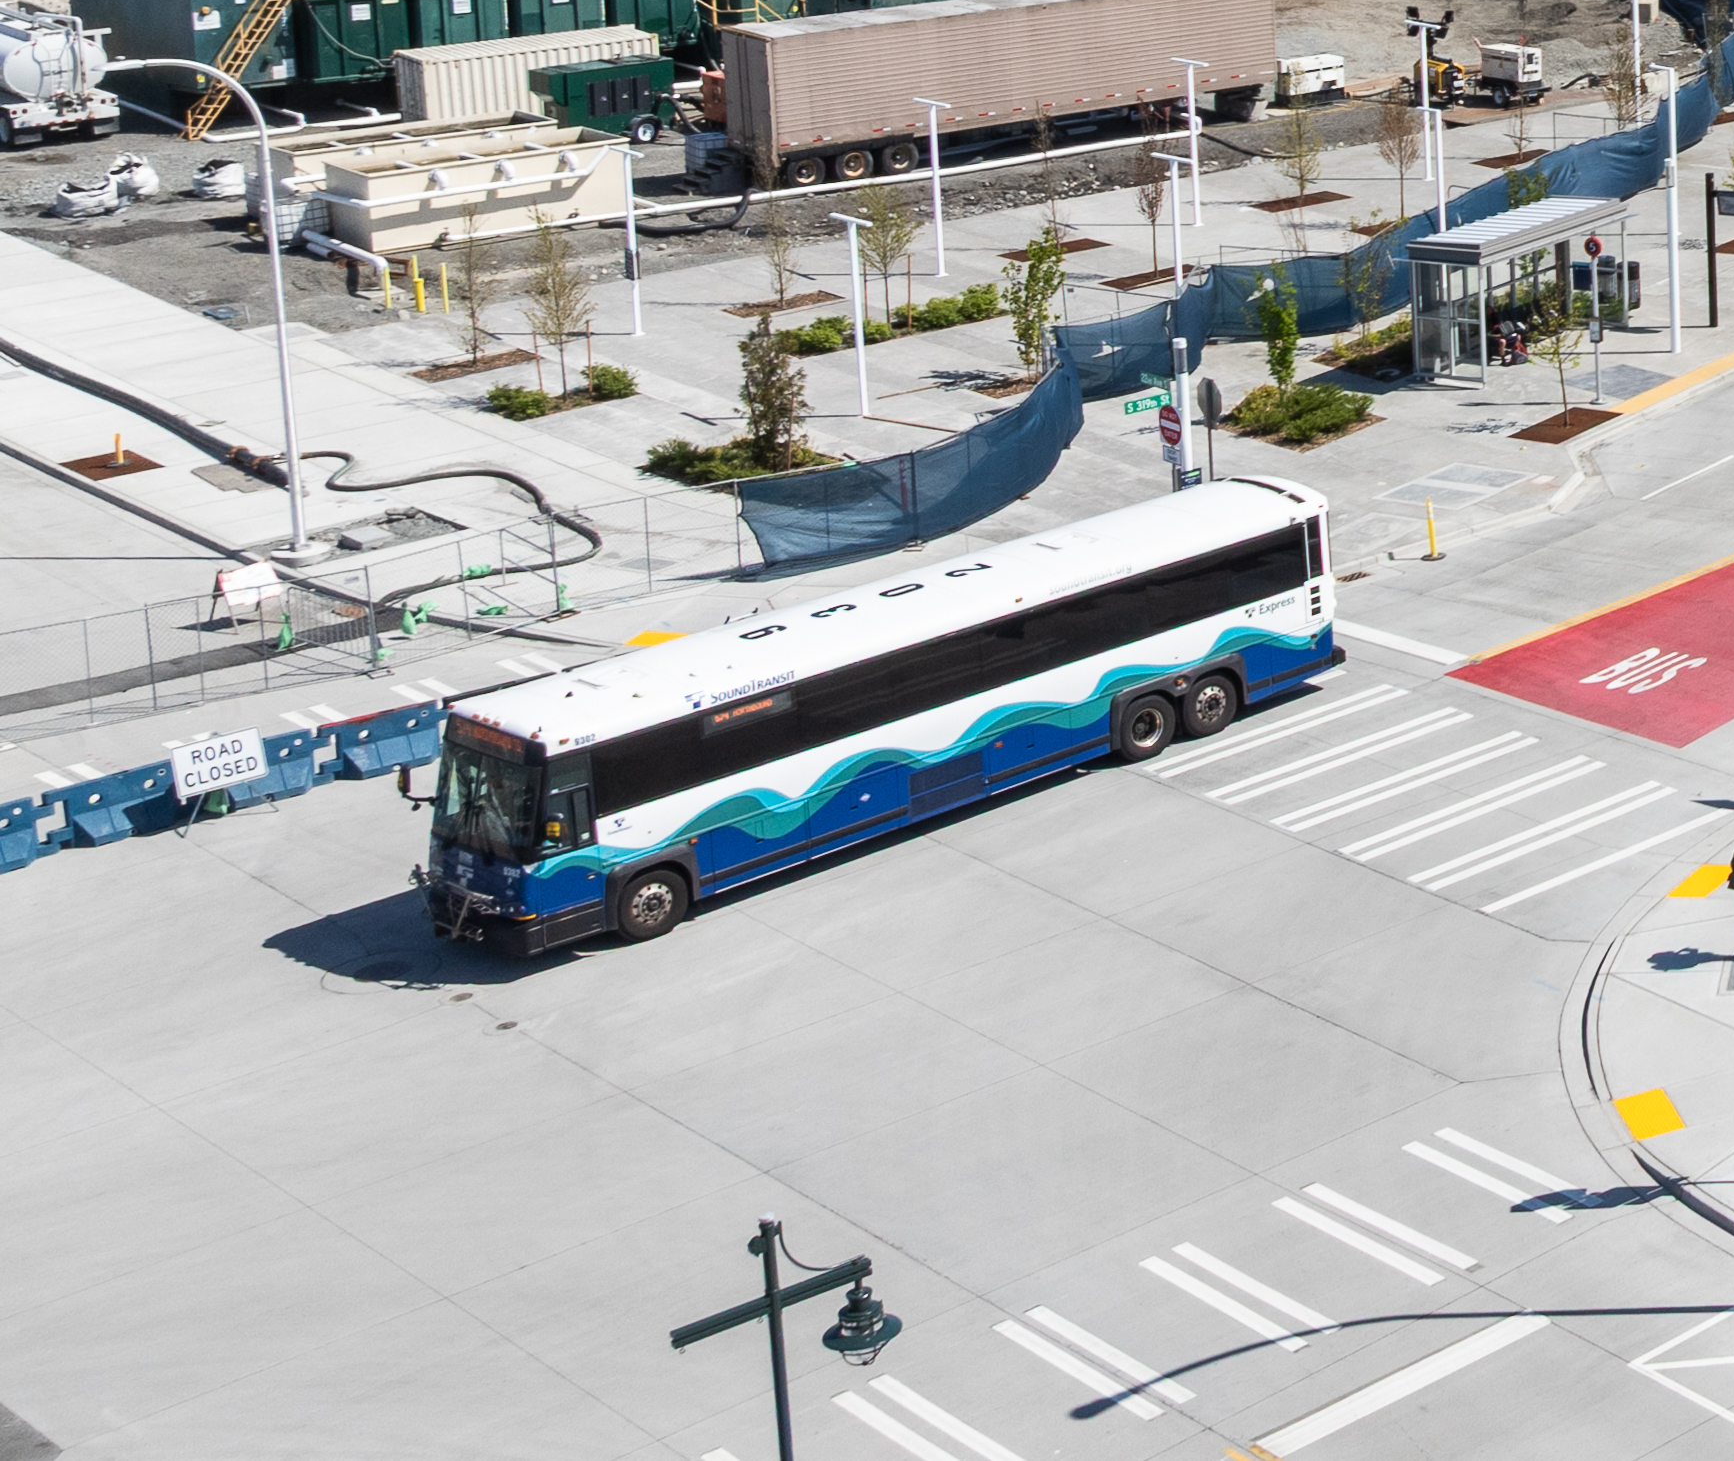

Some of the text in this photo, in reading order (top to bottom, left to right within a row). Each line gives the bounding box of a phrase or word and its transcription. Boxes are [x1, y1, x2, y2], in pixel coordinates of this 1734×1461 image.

[1589, 242, 1596, 252] 5
[1127, 403, 1133, 413] S
[1160, 395, 1170, 405] St
[1049, 563, 1133, 596] soundtransit.org
[1260, 596, 1296, 614] Express
[1579, 647, 1708, 694] BUS
[711, 670, 796, 704] SOUNDTRANSIT
[191, 739, 243, 765] ROAD
[184, 756, 258, 788] CLOSED
